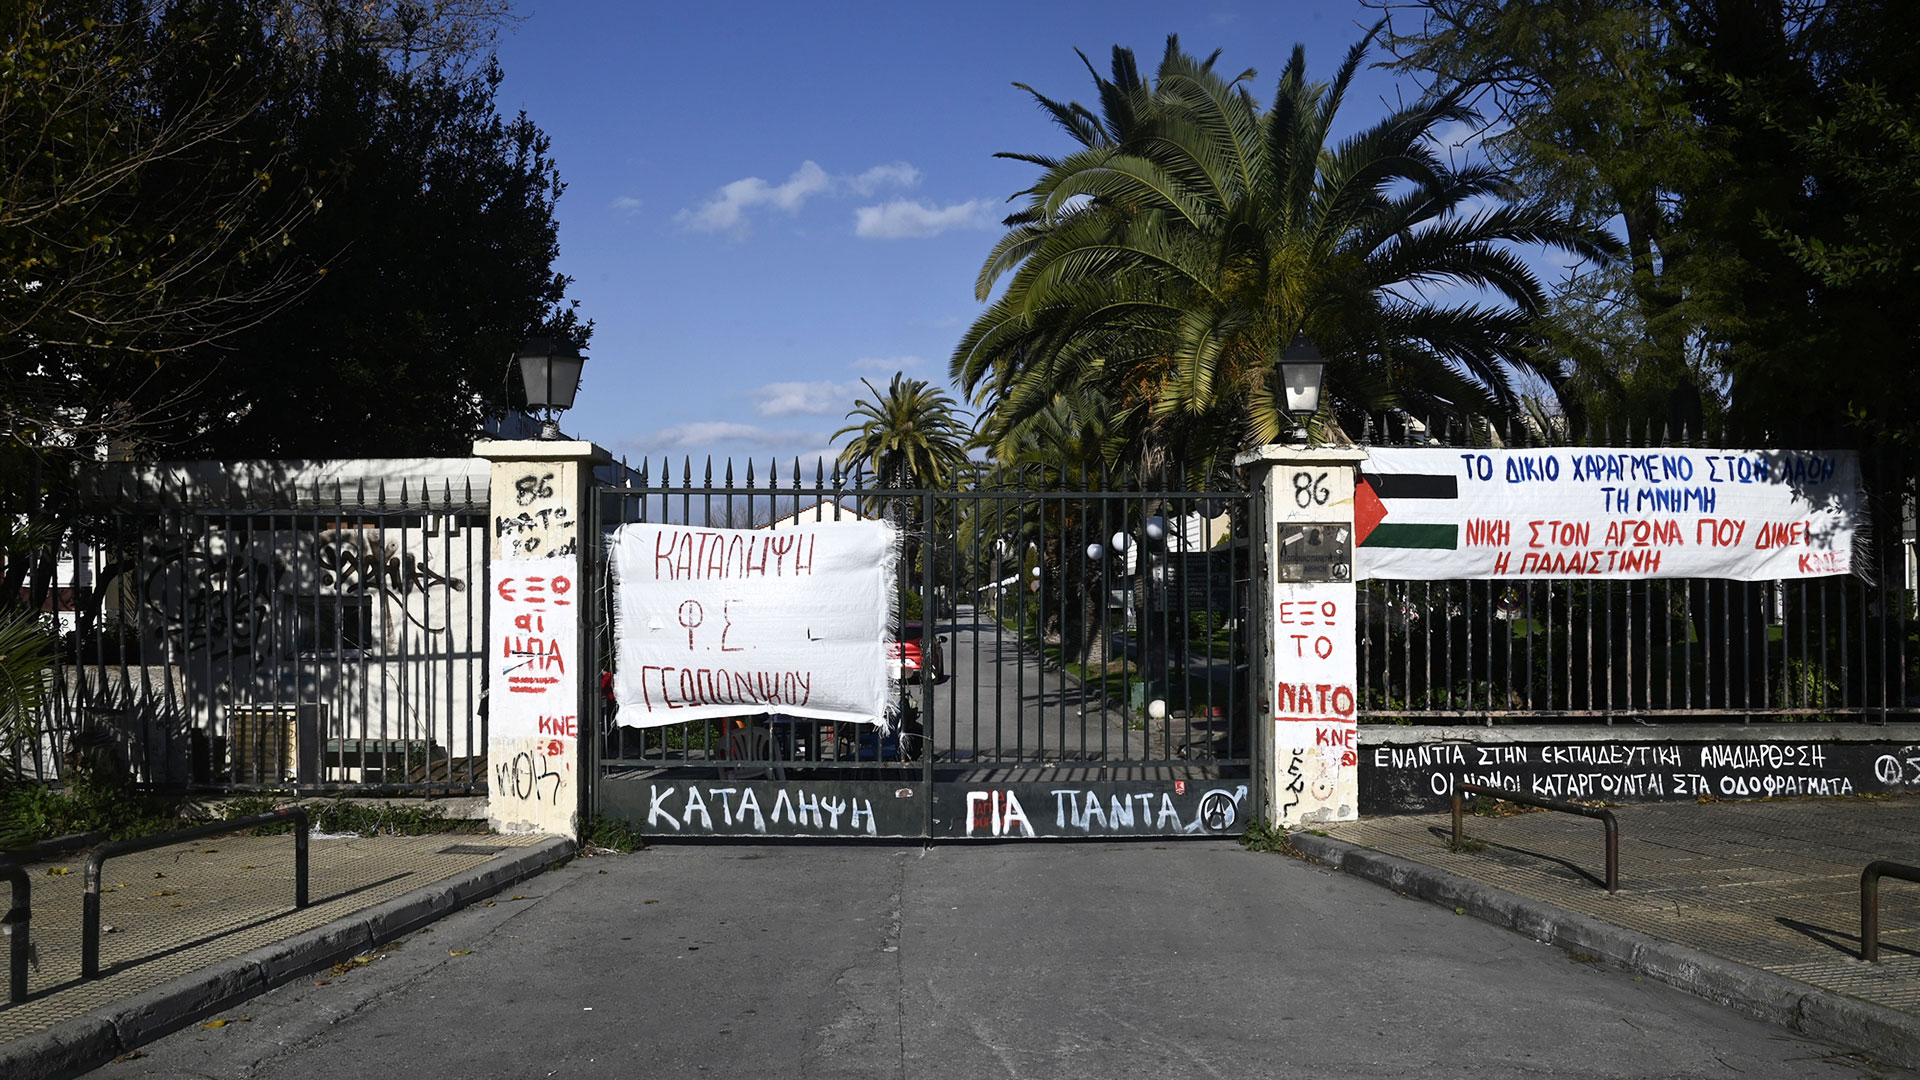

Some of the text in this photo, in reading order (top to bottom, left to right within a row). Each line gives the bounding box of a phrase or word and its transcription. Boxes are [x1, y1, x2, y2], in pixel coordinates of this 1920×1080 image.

[1461, 454, 1836, 485] ΤΟ ΔΙΚΙΟ ΧΑΡΑΓΜΕΝΟ ΣΤΩΝ ΛΑΩΝ
[1600, 486, 1716, 514] ΤΗ ΜΝΗΜΗ
[1466, 517, 1510, 548] ΝΙΚΗ
[1528, 519, 1590, 548] ΣΤΟΝ
[1605, 518, 1684, 548] ΑΓΩΝΑ
[1697, 518, 1746, 548] ΠΟΥ
[656, 531, 814, 580] ΚΑΤΑΛΗΨΗ
[1494, 549, 1661, 575] Η ΠΑΛΑΙΣΤΙΝΗ
[1280, 601, 1336, 627] ΕΞΩ
[1290, 635, 1333, 660] ΤΟ
[643, 665, 811, 712] ΓΕΩΠΟΝΙΚΟΥ
[1278, 682, 1354, 717] ΝΑΤΟ
[1375, 744, 1826, 769] ΕΝΑΝΤΙΑ ΣΤΗΝ ΕΚΠΑΙΔΕΥΤΙΚΗ ΑΝΑΔΙΑΡΘΩΣΗ
[1431, 772, 1454, 796] ΟΙ
[1532, 774, 1664, 797] ΚΑΤΑΡΓΟΥΝΤΑΙ
[1673, 773, 1711, 796] ΣΤΑ
[1720, 774, 1853, 797] ΟΔΟΦΡΑΓΜΑΤΑ
[648, 785, 1184, 837] ΚΑΤΑΛΗΨΗ ΓΙΑ ΠΑΝΤΑ
